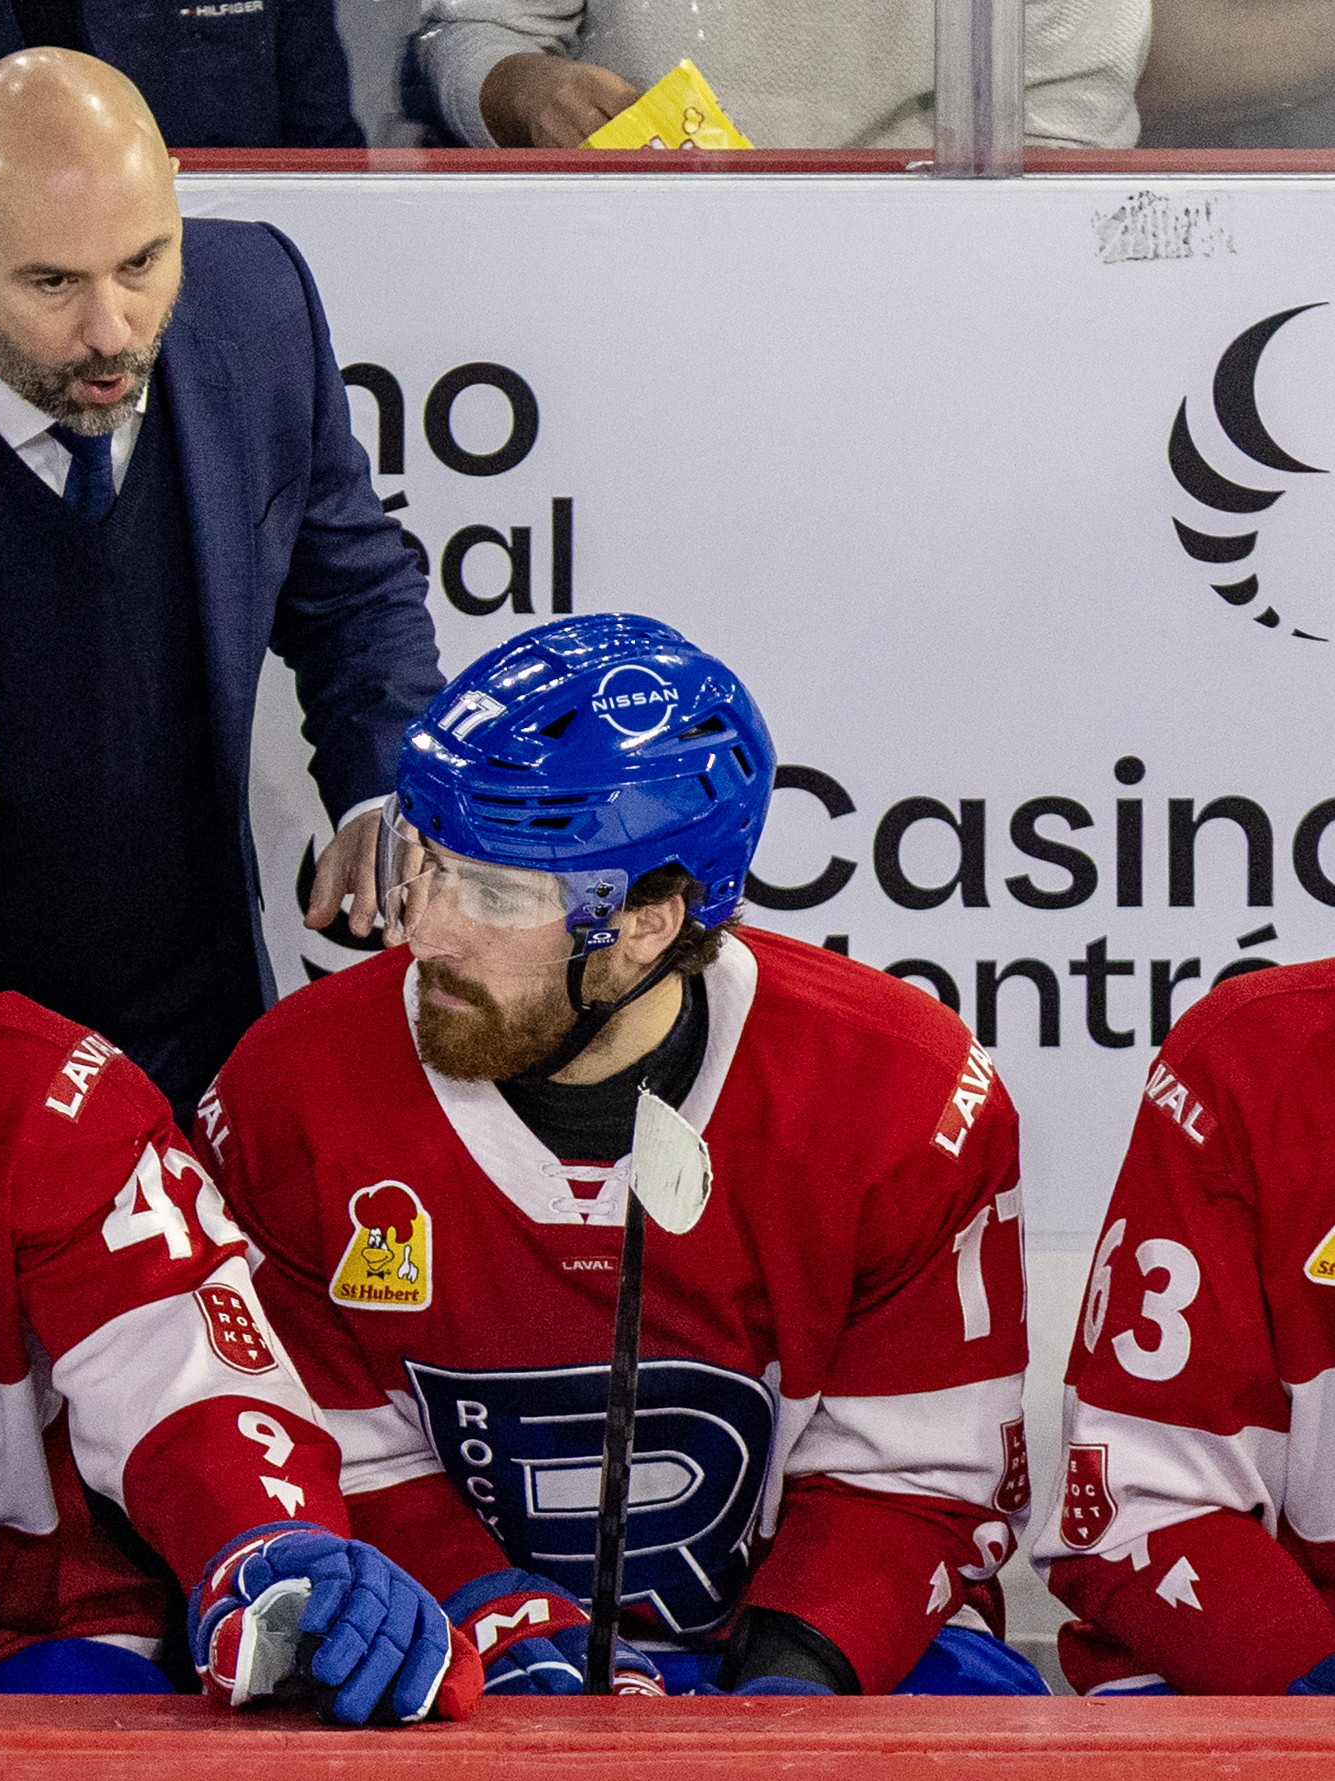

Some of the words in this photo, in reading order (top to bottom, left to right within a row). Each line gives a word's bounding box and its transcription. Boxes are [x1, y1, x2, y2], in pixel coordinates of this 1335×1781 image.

[195, 1, 264, 16] HILFIGER
[592, 688, 679, 713] NISSAN
[438, 690, 506, 740] 17
[101, 1141, 266, 1279] 42
[562, 1260, 614, 1271] LAVAL
[211, 1294, 242, 1310] LE
[340, 1283, 358, 1298] St
[360, 1286, 420, 1302] Hubert
[1083, 1218, 1201, 1382] 63
